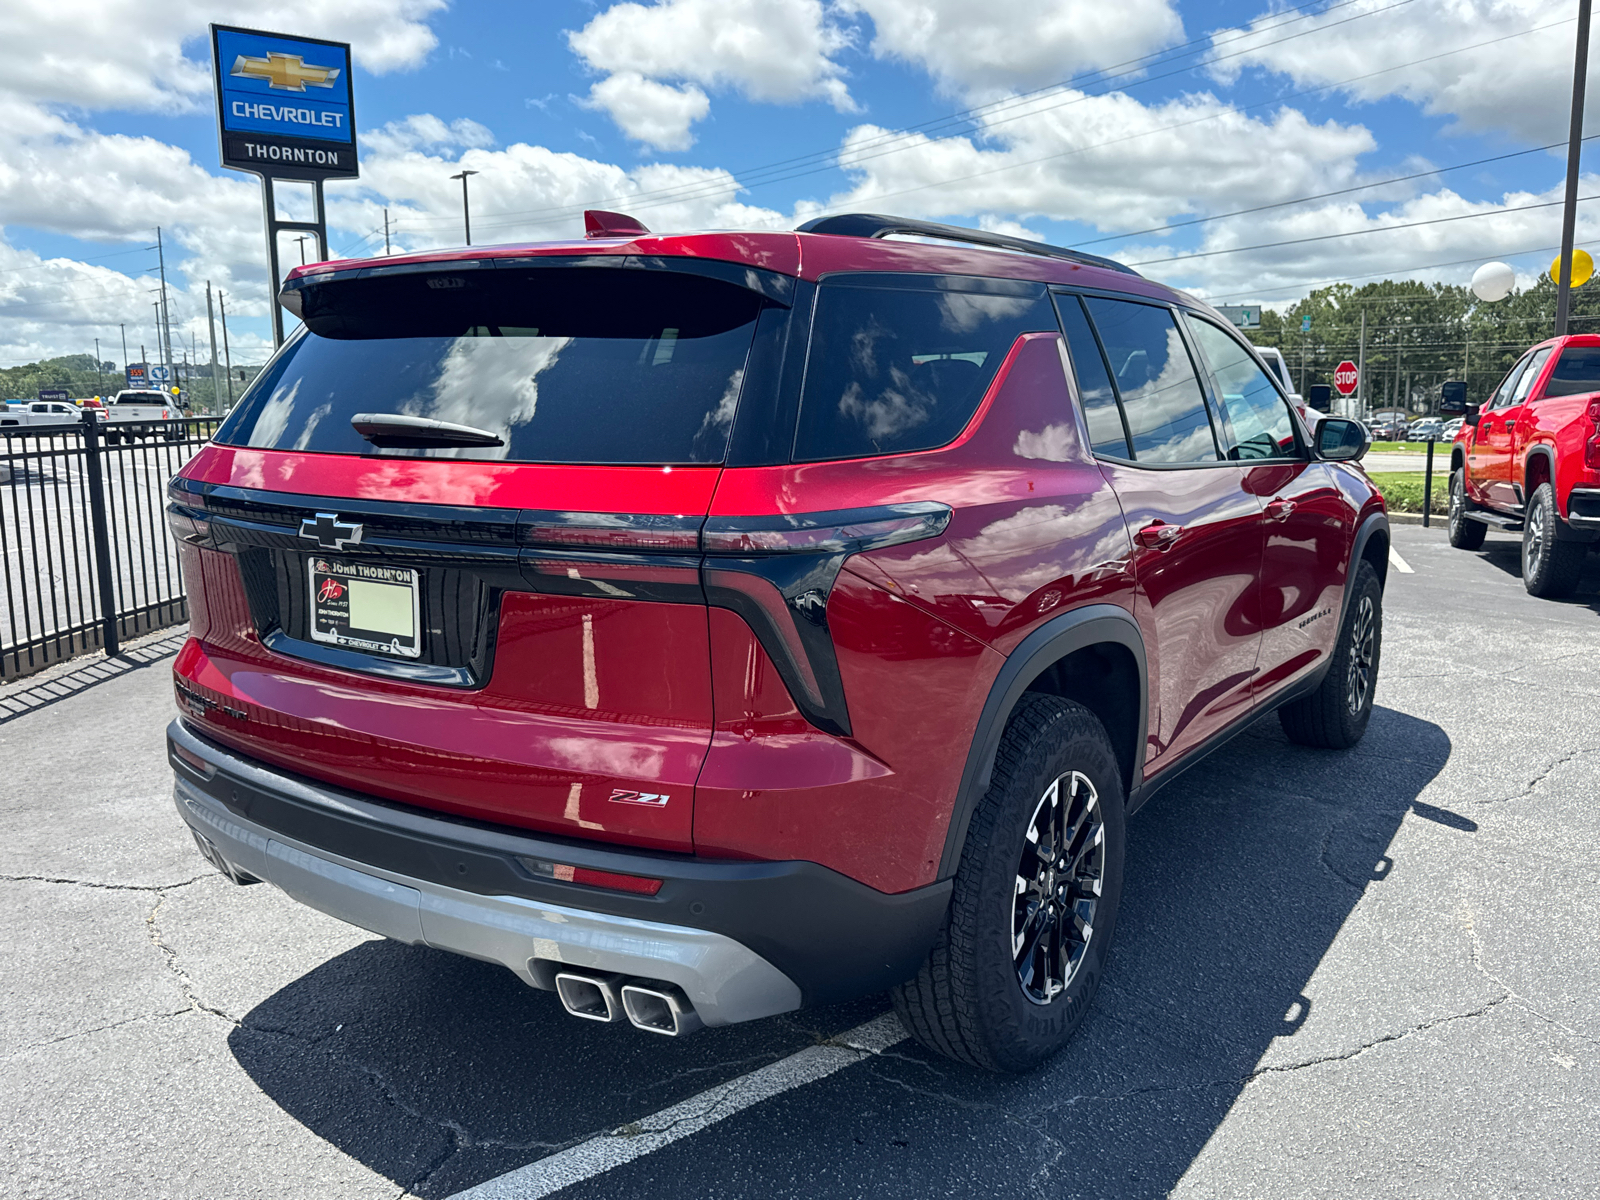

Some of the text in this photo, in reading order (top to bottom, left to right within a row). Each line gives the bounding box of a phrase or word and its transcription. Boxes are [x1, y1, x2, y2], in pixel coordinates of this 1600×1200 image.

[232, 101, 343, 127] CHEVROLET
[245, 143, 338, 165] THORNTON
[1336, 371, 1357, 385] STOP
[332, 562, 411, 582] JOHN THORNTON
[348, 640, 379, 650] CHEVROLET
[608, 788, 670, 808] Z71
